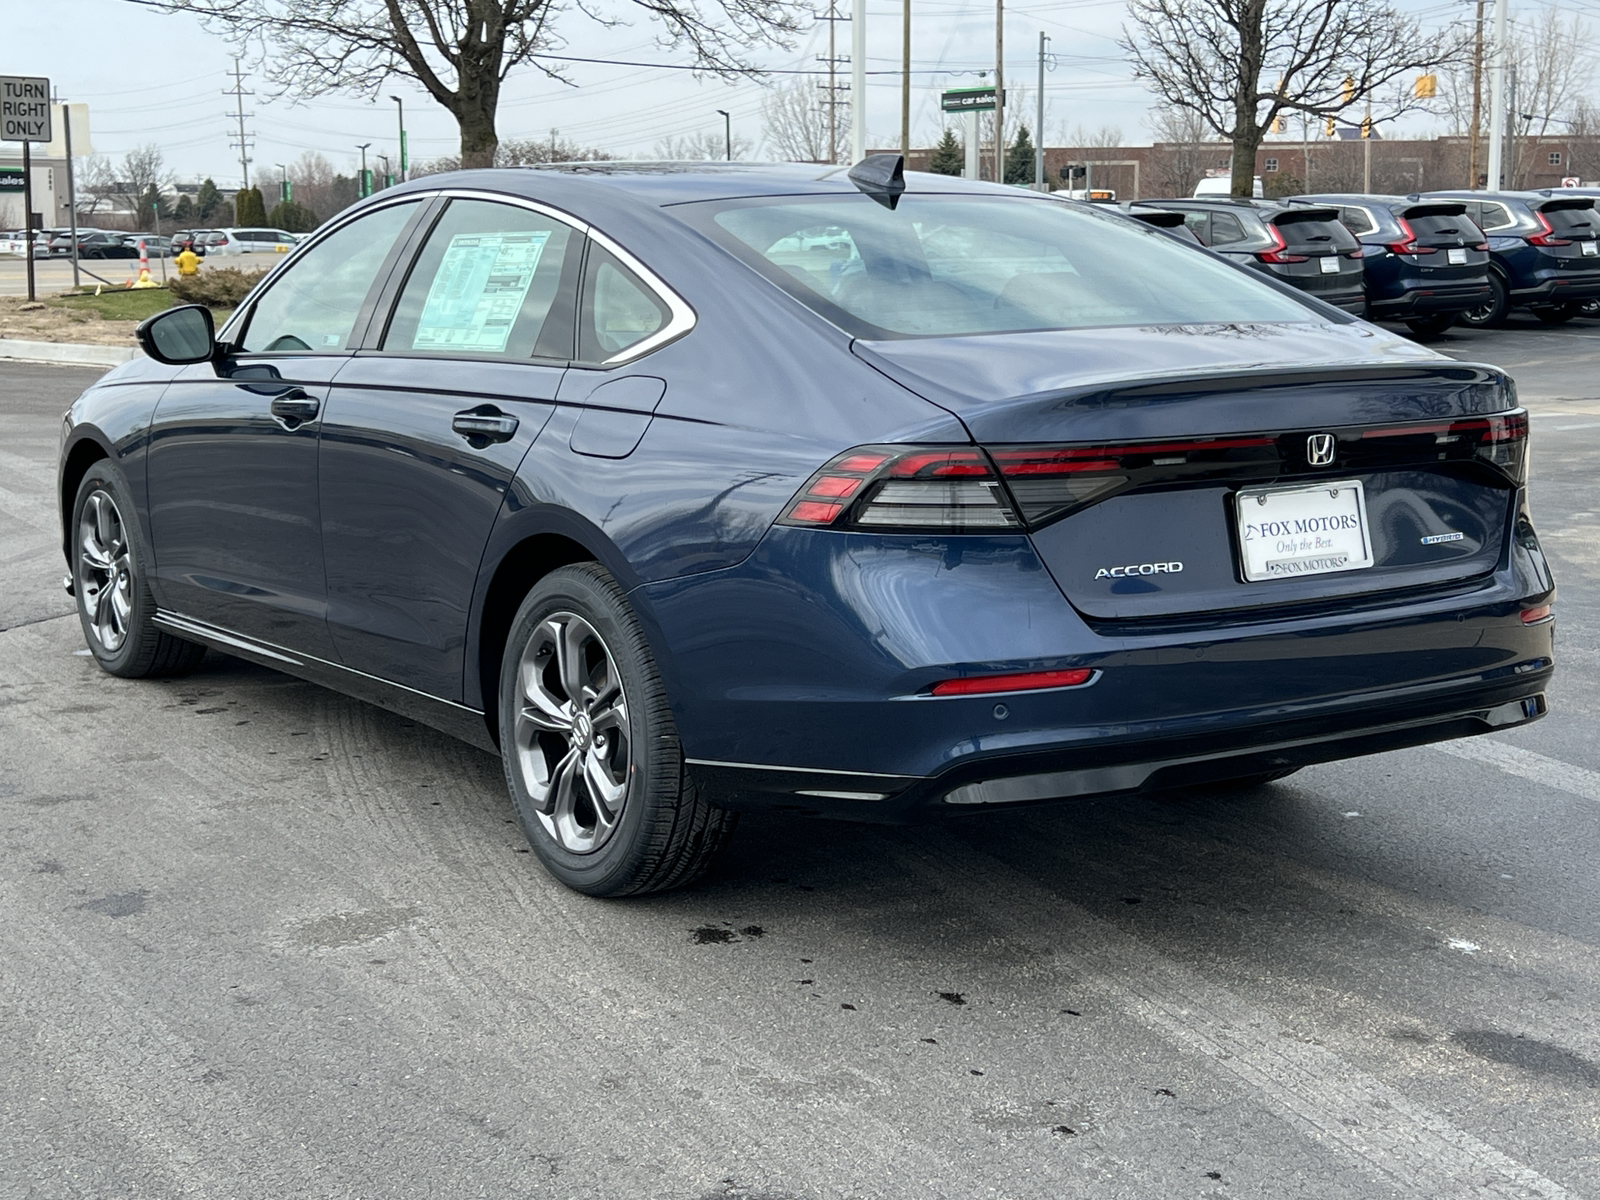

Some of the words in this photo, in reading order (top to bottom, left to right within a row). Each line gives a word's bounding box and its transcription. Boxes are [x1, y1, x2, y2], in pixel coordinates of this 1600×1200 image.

[4, 83, 44, 98] TURN
[3, 102, 46, 117] RIGHT
[6, 120, 45, 136] ONLY
[0, 175, 25, 185] ales
[1260, 520, 1291, 538] FOX
[1294, 515, 1357, 534] MOTORS
[1276, 539, 1298, 555] Only
[1299, 537, 1312, 550] the
[1095, 562, 1183, 579] ACCORD
[1282, 561, 1302, 574] FOX
[1302, 556, 1344, 572] MOTORS
